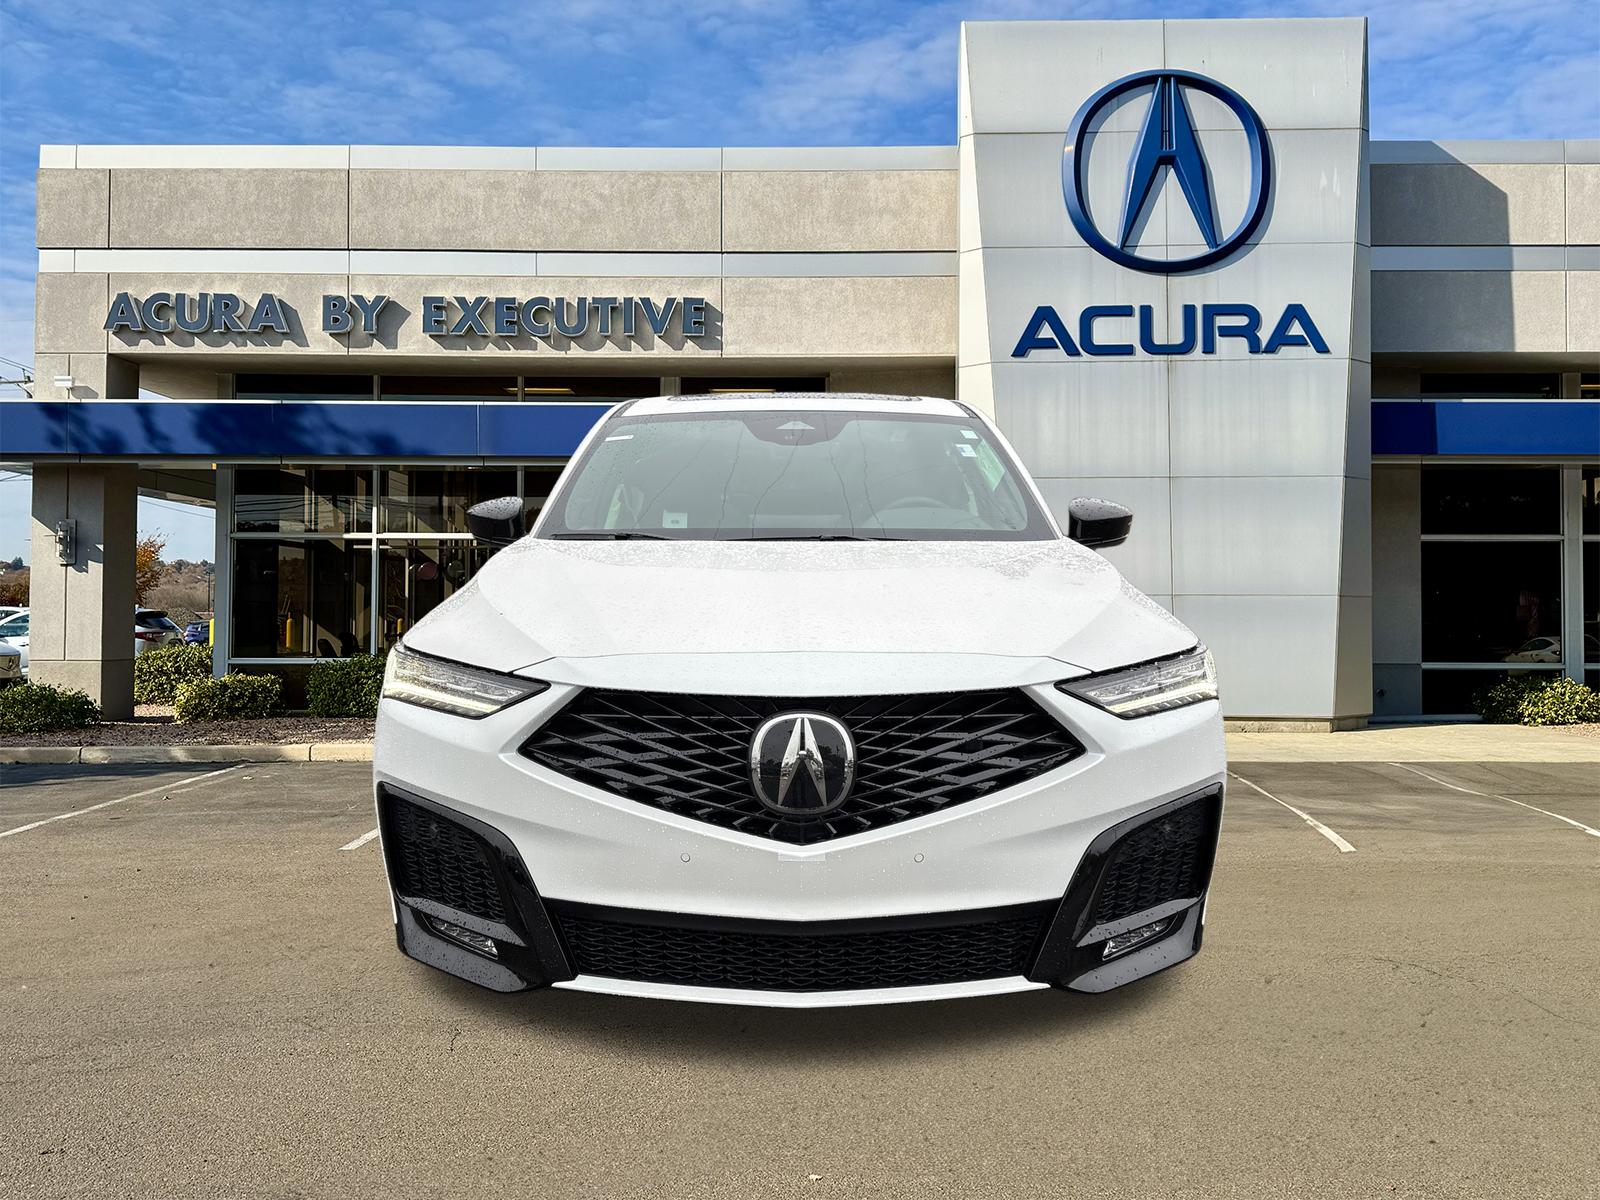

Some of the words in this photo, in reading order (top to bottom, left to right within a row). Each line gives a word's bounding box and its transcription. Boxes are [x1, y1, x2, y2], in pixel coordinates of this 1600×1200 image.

[103, 292, 290, 333] ACURA
[322, 294, 391, 334] BY
[422, 296, 706, 337] EXECUTIVE
[1010, 303, 1332, 357] ACURA
